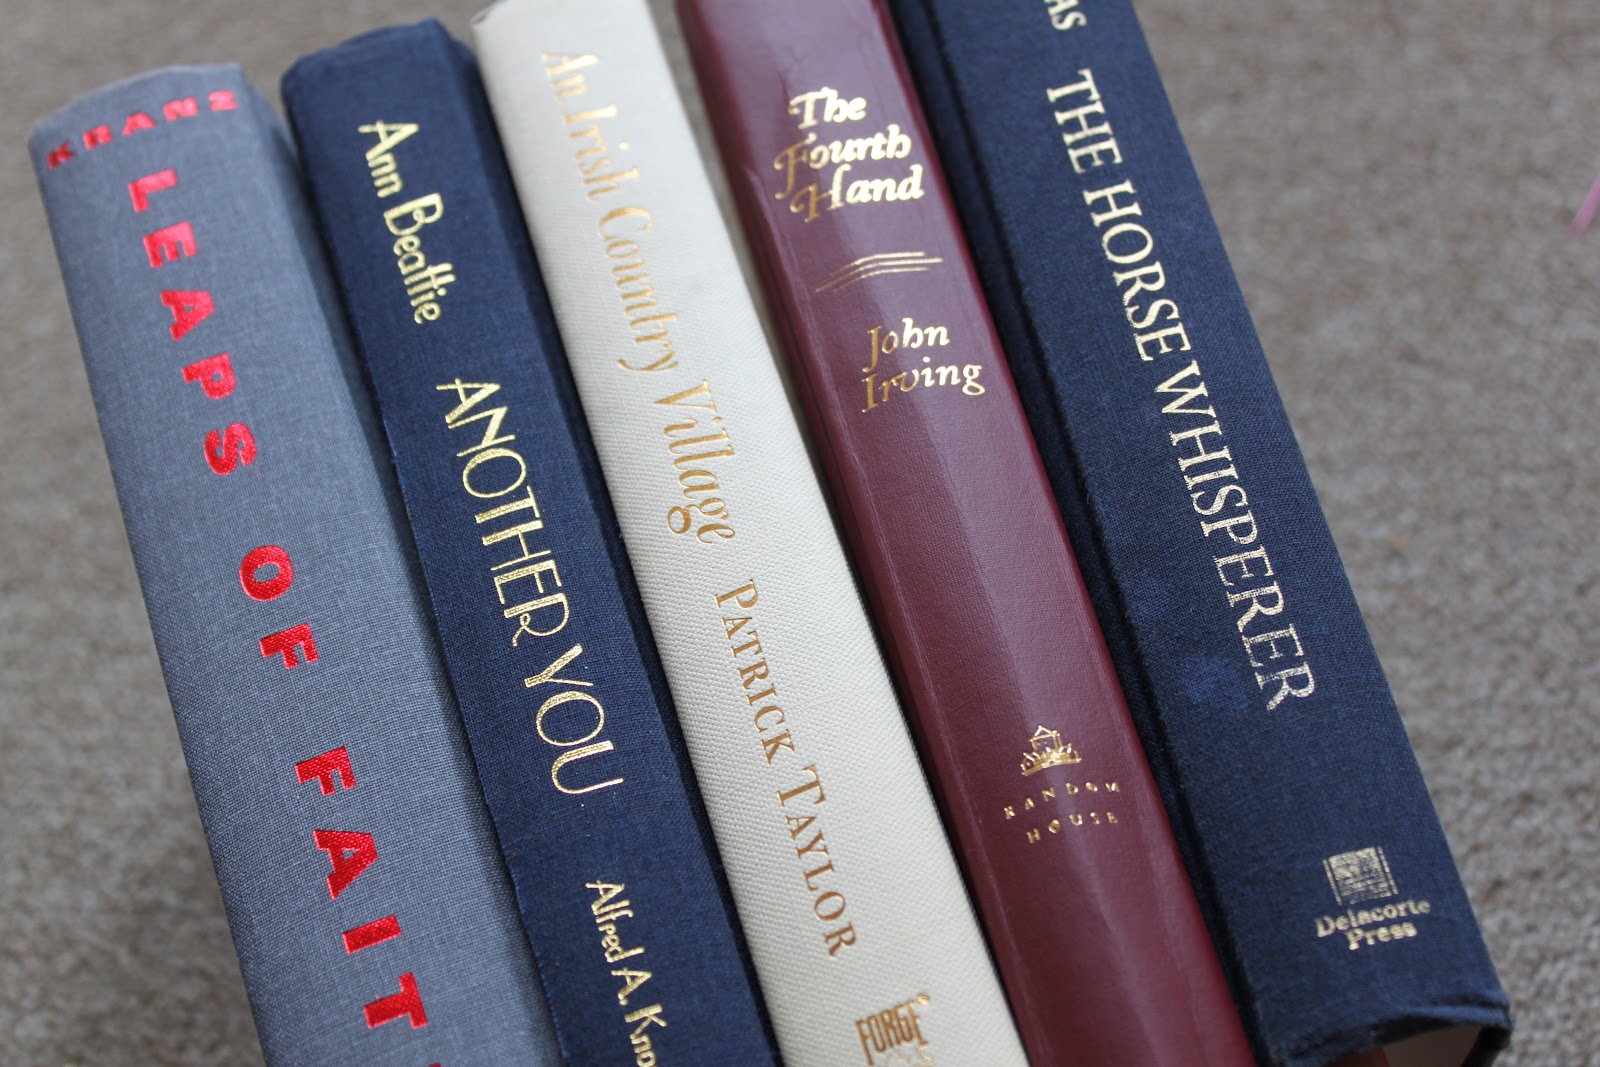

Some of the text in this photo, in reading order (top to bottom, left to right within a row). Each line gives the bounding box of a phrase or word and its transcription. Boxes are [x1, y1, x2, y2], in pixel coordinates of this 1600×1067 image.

[47, 90, 239, 169] KRANZ
[788, 87, 867, 130] The
[1046, 69, 1123, 174] THE
[774, 124, 912, 199] Fourth
[789, 164, 925, 223] Hand
[358, 120, 456, 325] Ann Beattie
[540, 50, 735, 544] An Irish Country Village
[1083, 179, 1191, 362] HORSE
[862, 318, 950, 372] John
[861, 356, 986, 413] Irving
[1154, 359, 1316, 710] WHISPERER
[128, 169, 441, 1067] LEAPS OF FAIT
[436, 378, 624, 794] ANOTHER YOU
[714, 579, 857, 959] PATRICK TAYLOR
[1004, 782, 1120, 820] RANDOM
[1027, 811, 1118, 843] HOUSE
[585, 880, 645, 963] Alfred
[1315, 899, 1431, 938] Delacorte
[1345, 921, 1418, 950] Press
[611, 967, 652, 1006] A.
